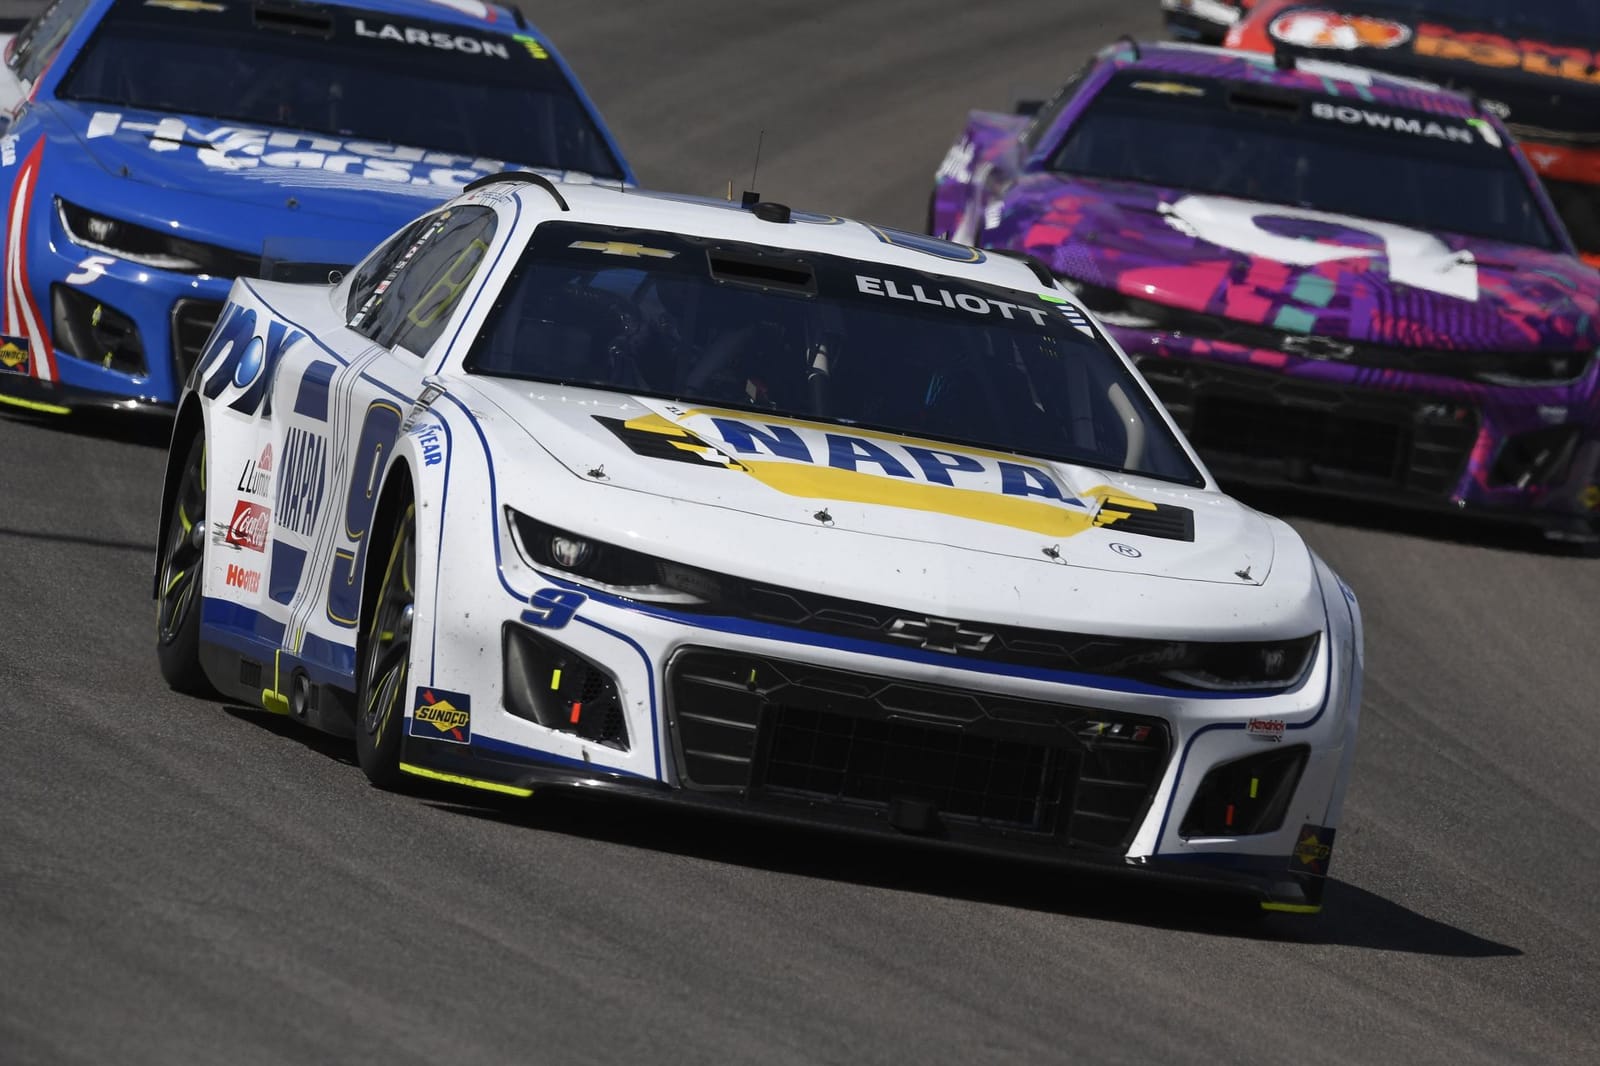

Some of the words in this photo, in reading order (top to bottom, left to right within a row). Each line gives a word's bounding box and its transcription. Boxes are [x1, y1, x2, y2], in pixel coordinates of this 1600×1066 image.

[355, 20, 509, 59] LARSON
[1311, 102, 1474, 144] BOWMAN
[66, 257, 115, 285] 5
[855, 274, 1048, 327] ELLIOTT
[710, 416, 1087, 509] NAPA
[226, 563, 261, 594] HOOTERS
[519, 588, 589, 630] 9
[416, 707, 468, 726] SUNOCO
